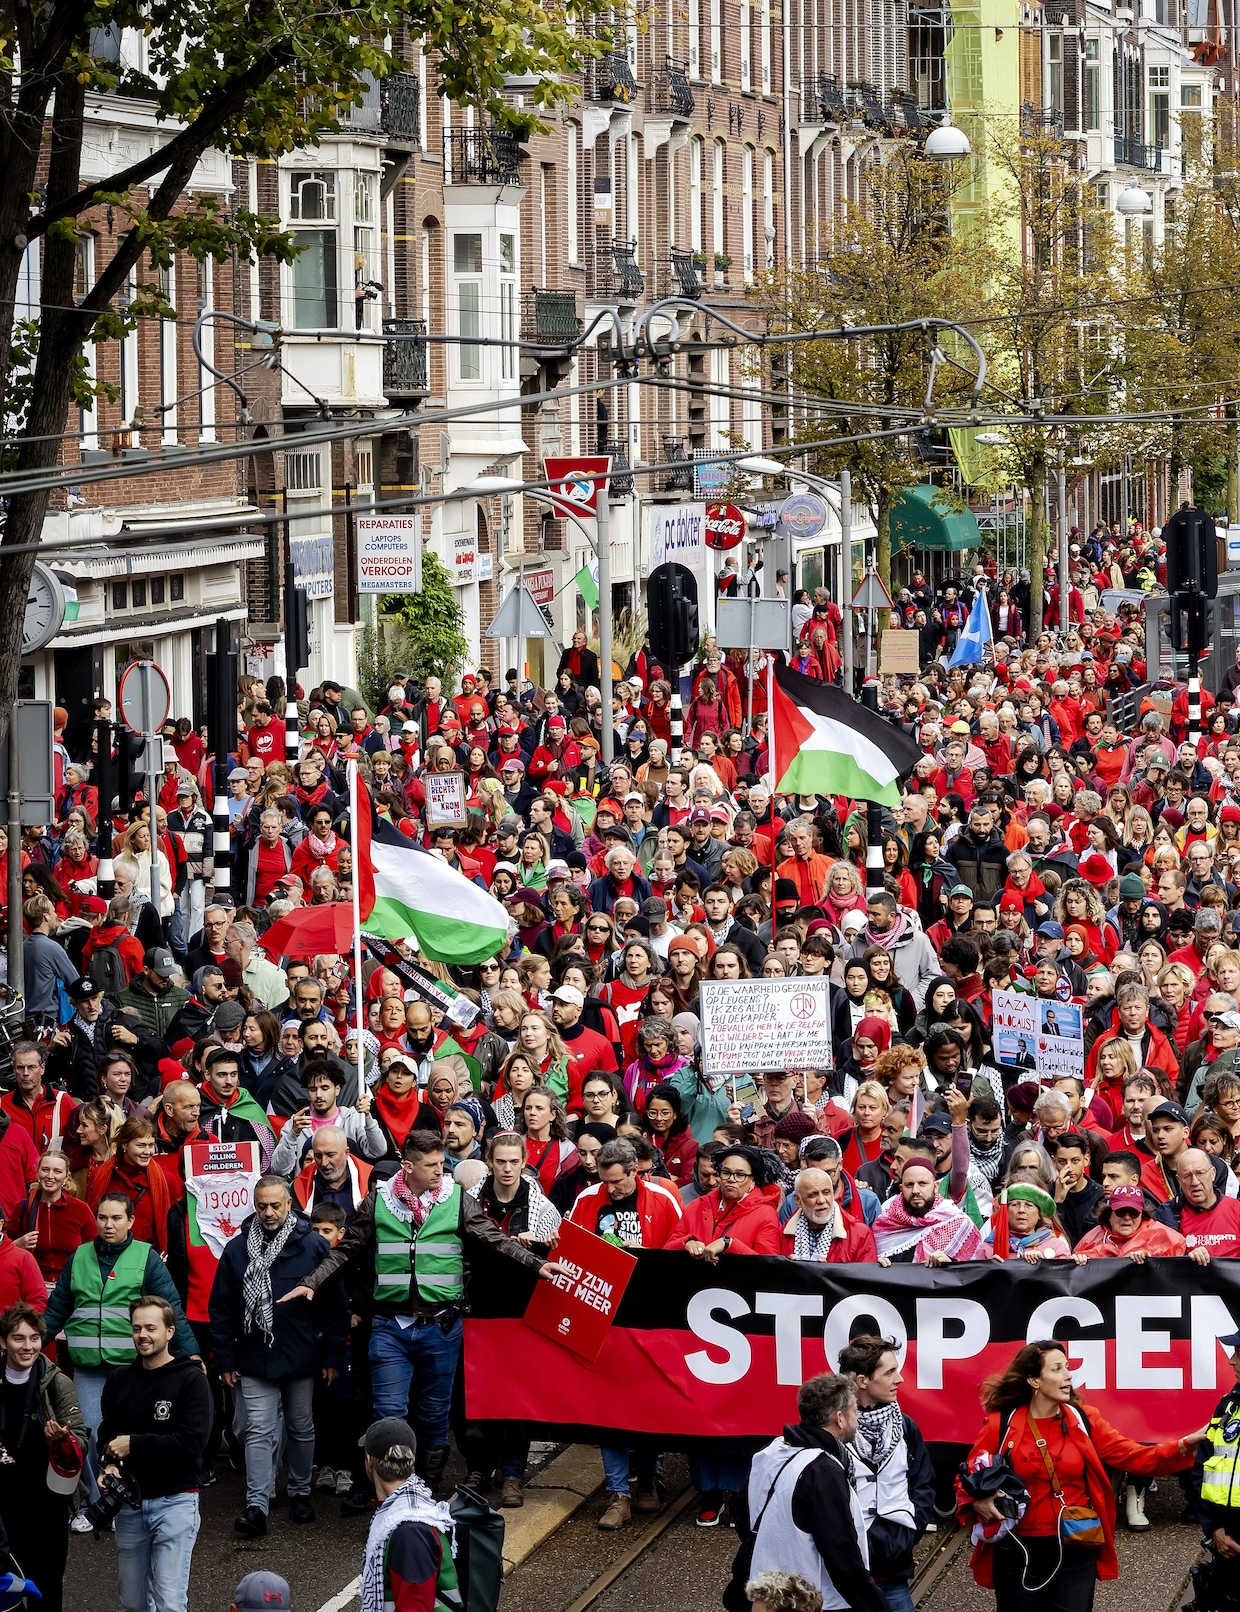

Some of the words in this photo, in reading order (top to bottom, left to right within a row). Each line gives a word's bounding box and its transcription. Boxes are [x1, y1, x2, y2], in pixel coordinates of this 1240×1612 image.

[359, 520, 413, 529] REPARATIES
[371, 535, 402, 543] LAPTOPS
[365, 543, 408, 551] COMPUTERS
[360, 557, 413, 565] ONDERDELEN
[361, 566, 413, 576] VERKOOP
[361, 581, 413, 589] MEGAMASTERS
[431, 786, 455, 794] RECHTS
[706, 987, 716, 996] IS
[716, 986, 730, 995] DE
[733, 984, 780, 994] WAARHEID
[706, 996, 720, 1005] OP
[721, 995, 761, 1004] LEUGENS
[997, 996, 1030, 1013] GAZA
[725, 1005, 744, 1013] ZEG
[756, 1022, 772, 1031] HEB
[993, 1013, 1036, 1032] HOLOCAUST
[710, 1033, 724, 1041] ALS
[807, 1030, 819, 1038] ME
[718, 1051, 742, 1060] TRUMP
[761, 1050, 775, 1058] DAT
[784, 1049, 805, 1057] VREDE
[707, 1062, 720, 1070] DAT
[721, 1060, 741, 1069] GAZA
[203, 1162, 243, 1170] CHILDEREN
[205, 1187, 248, 1210] 19000
[581, 1271, 613, 1298] ZIJN
[574, 1284, 612, 1316] MEER
[683, 1287, 991, 1390] STOP
